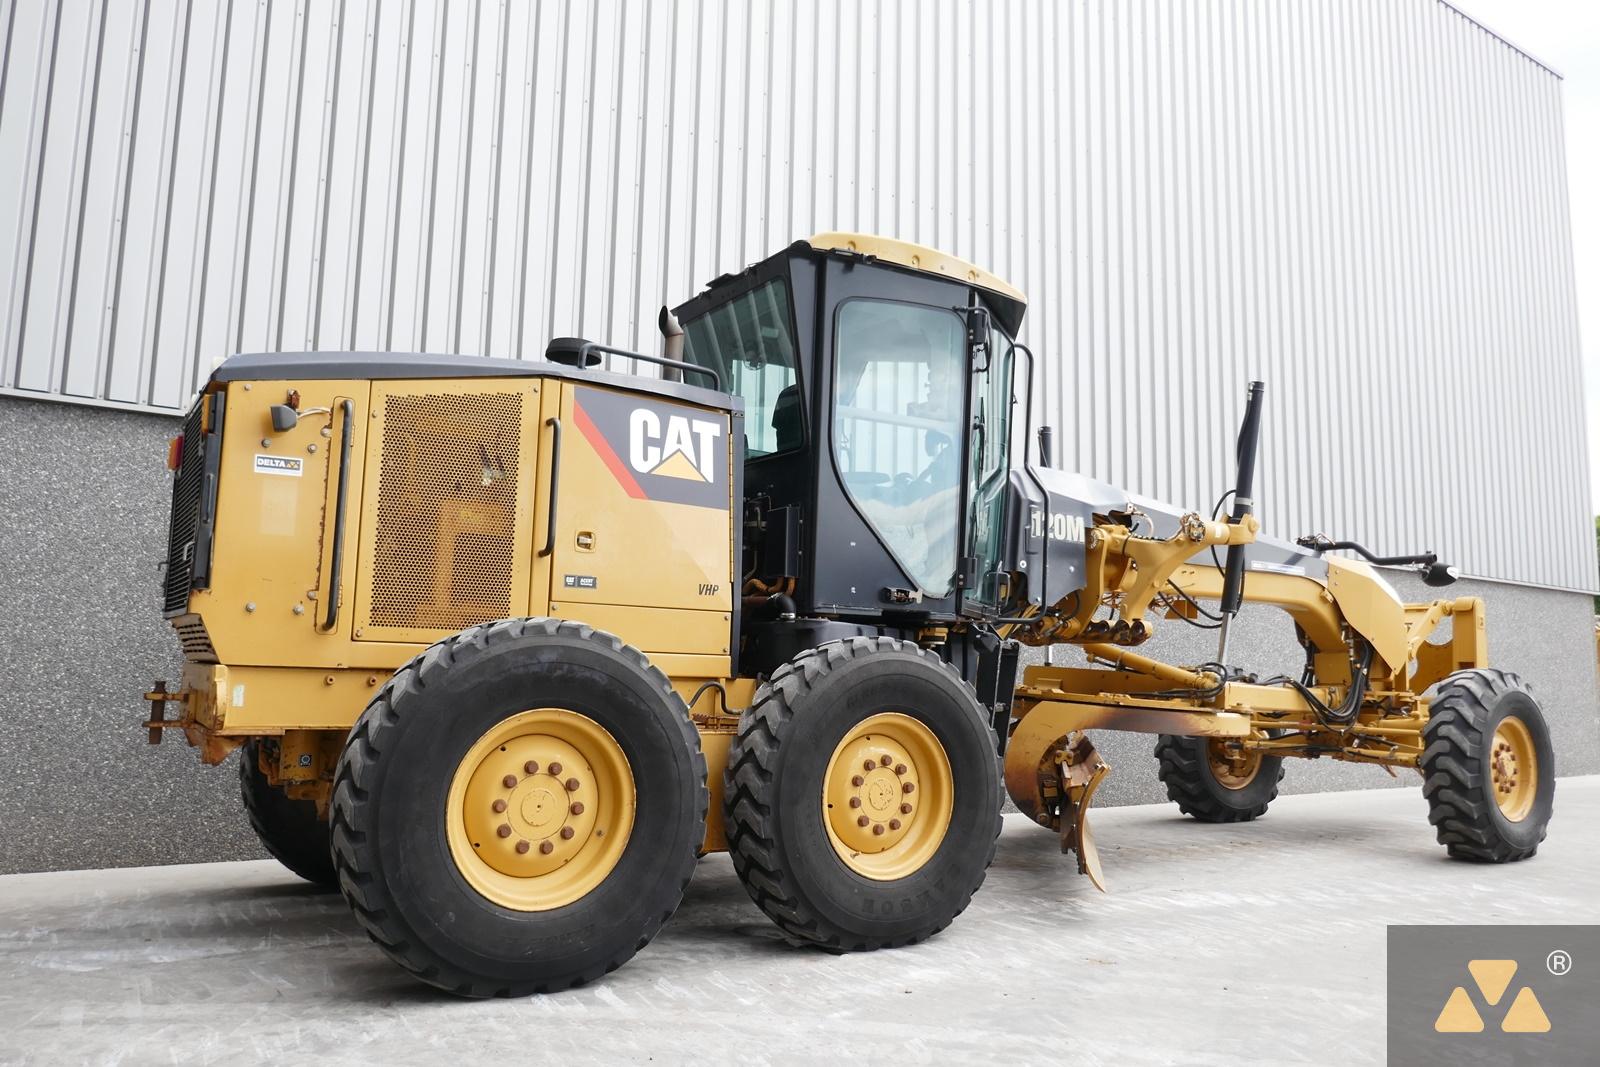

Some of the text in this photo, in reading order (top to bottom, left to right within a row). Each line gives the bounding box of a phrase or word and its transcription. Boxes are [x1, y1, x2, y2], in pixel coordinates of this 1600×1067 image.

[630, 408, 720, 483] CAT
[257, 458, 286, 467] DELTA
[1031, 510, 1085, 542] 120M
[698, 584, 719, 596] VHP
